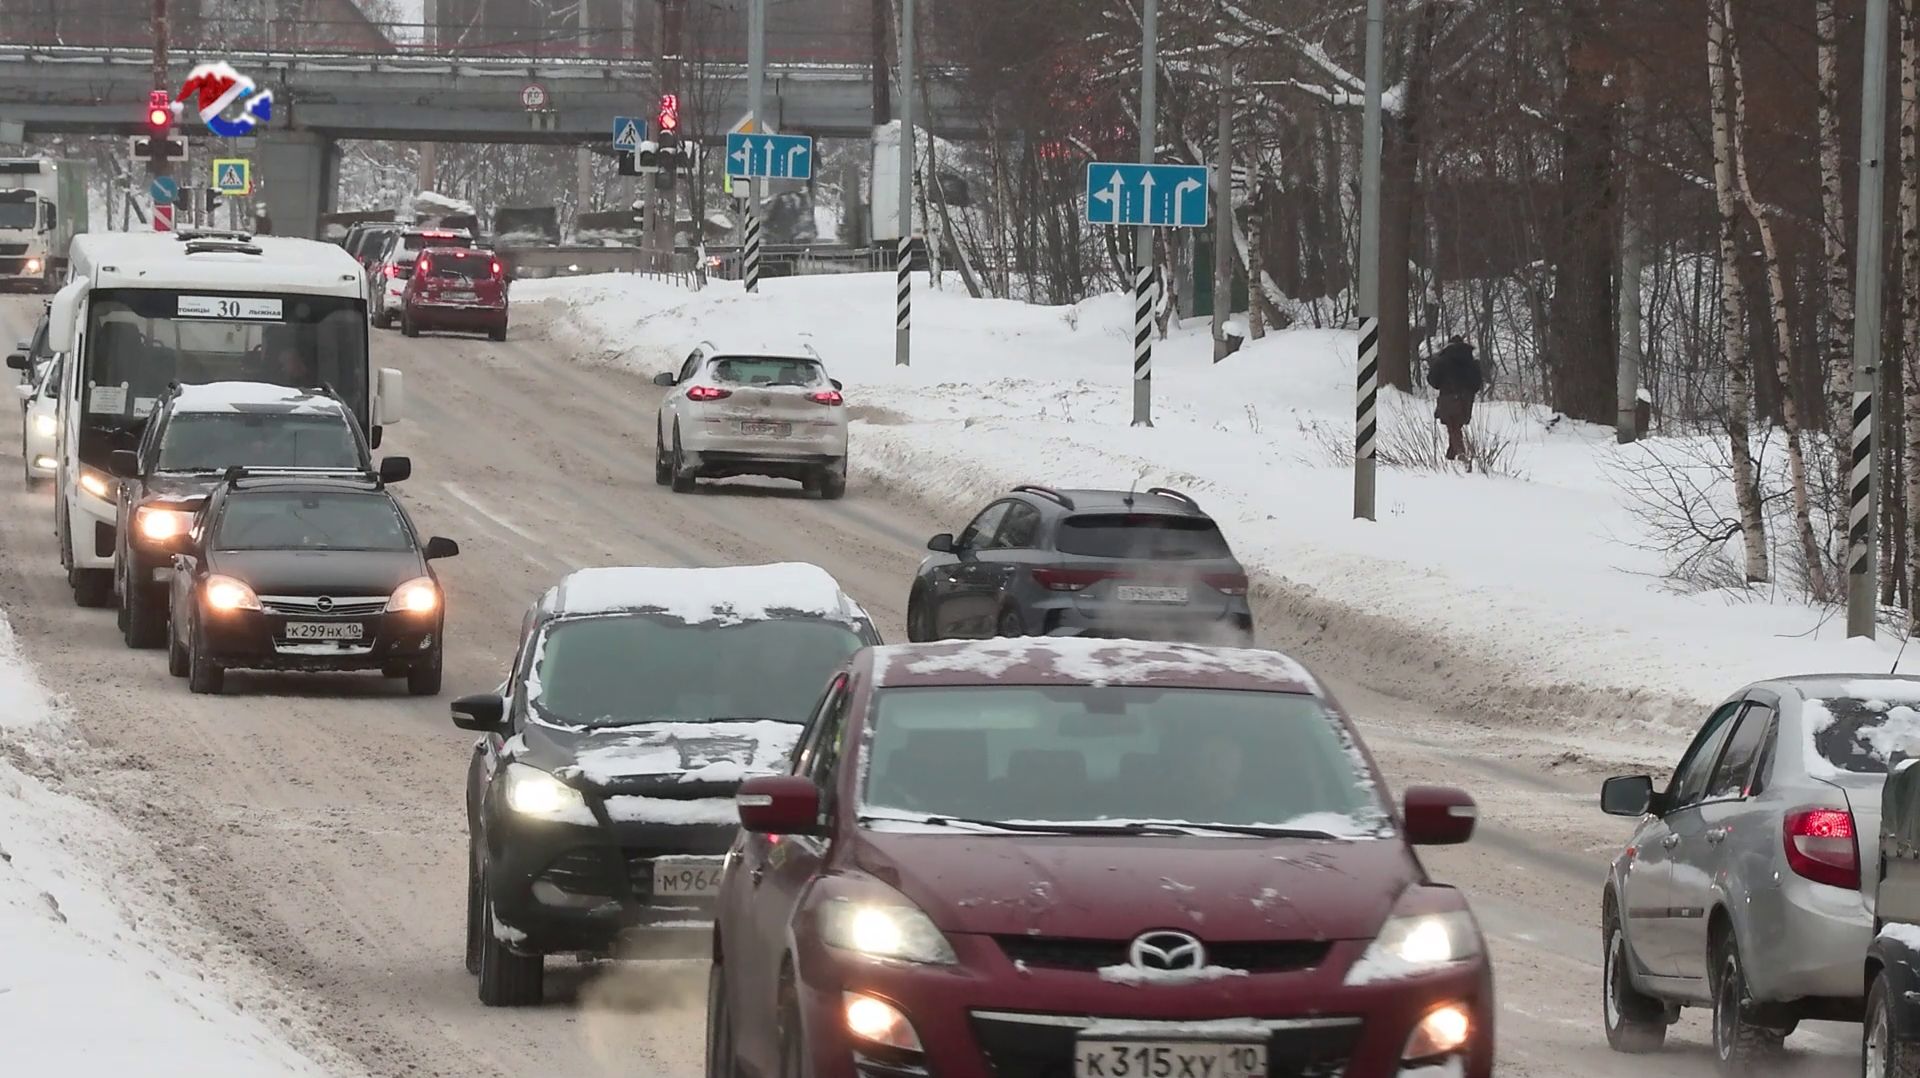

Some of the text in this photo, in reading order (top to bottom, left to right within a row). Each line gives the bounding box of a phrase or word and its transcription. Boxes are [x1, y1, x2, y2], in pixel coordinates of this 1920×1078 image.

[217, 300, 240, 318] 30
[291, 624, 358, 637] К299НХ 10
[1229, 1048, 1257, 1071] 10
